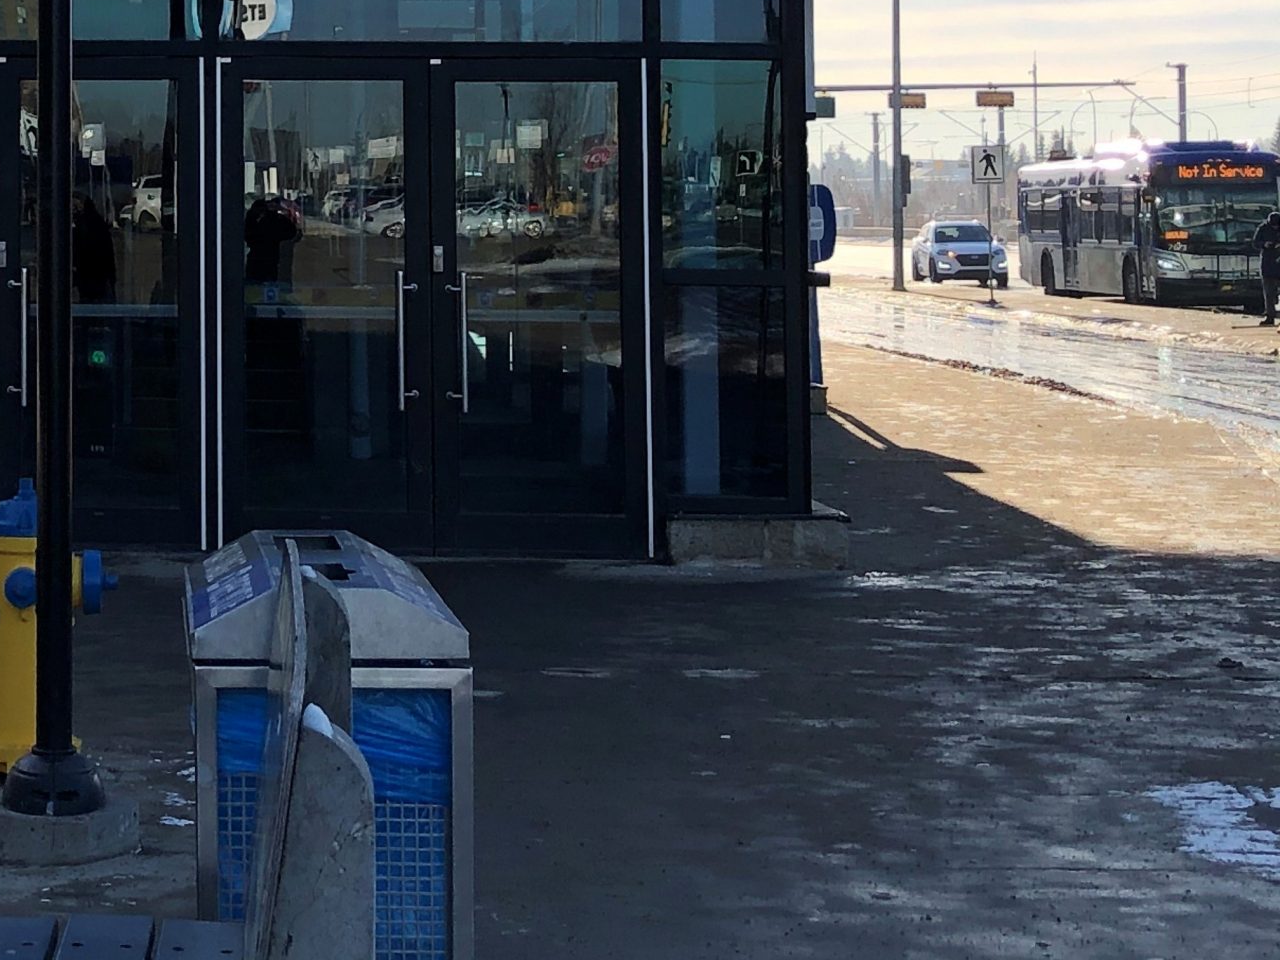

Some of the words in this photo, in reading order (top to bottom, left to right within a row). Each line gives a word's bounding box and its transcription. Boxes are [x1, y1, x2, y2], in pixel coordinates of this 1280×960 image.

[1178, 165, 1200, 178] Not
[1202, 164, 1217, 178] In
[1219, 164, 1264, 178] Service
